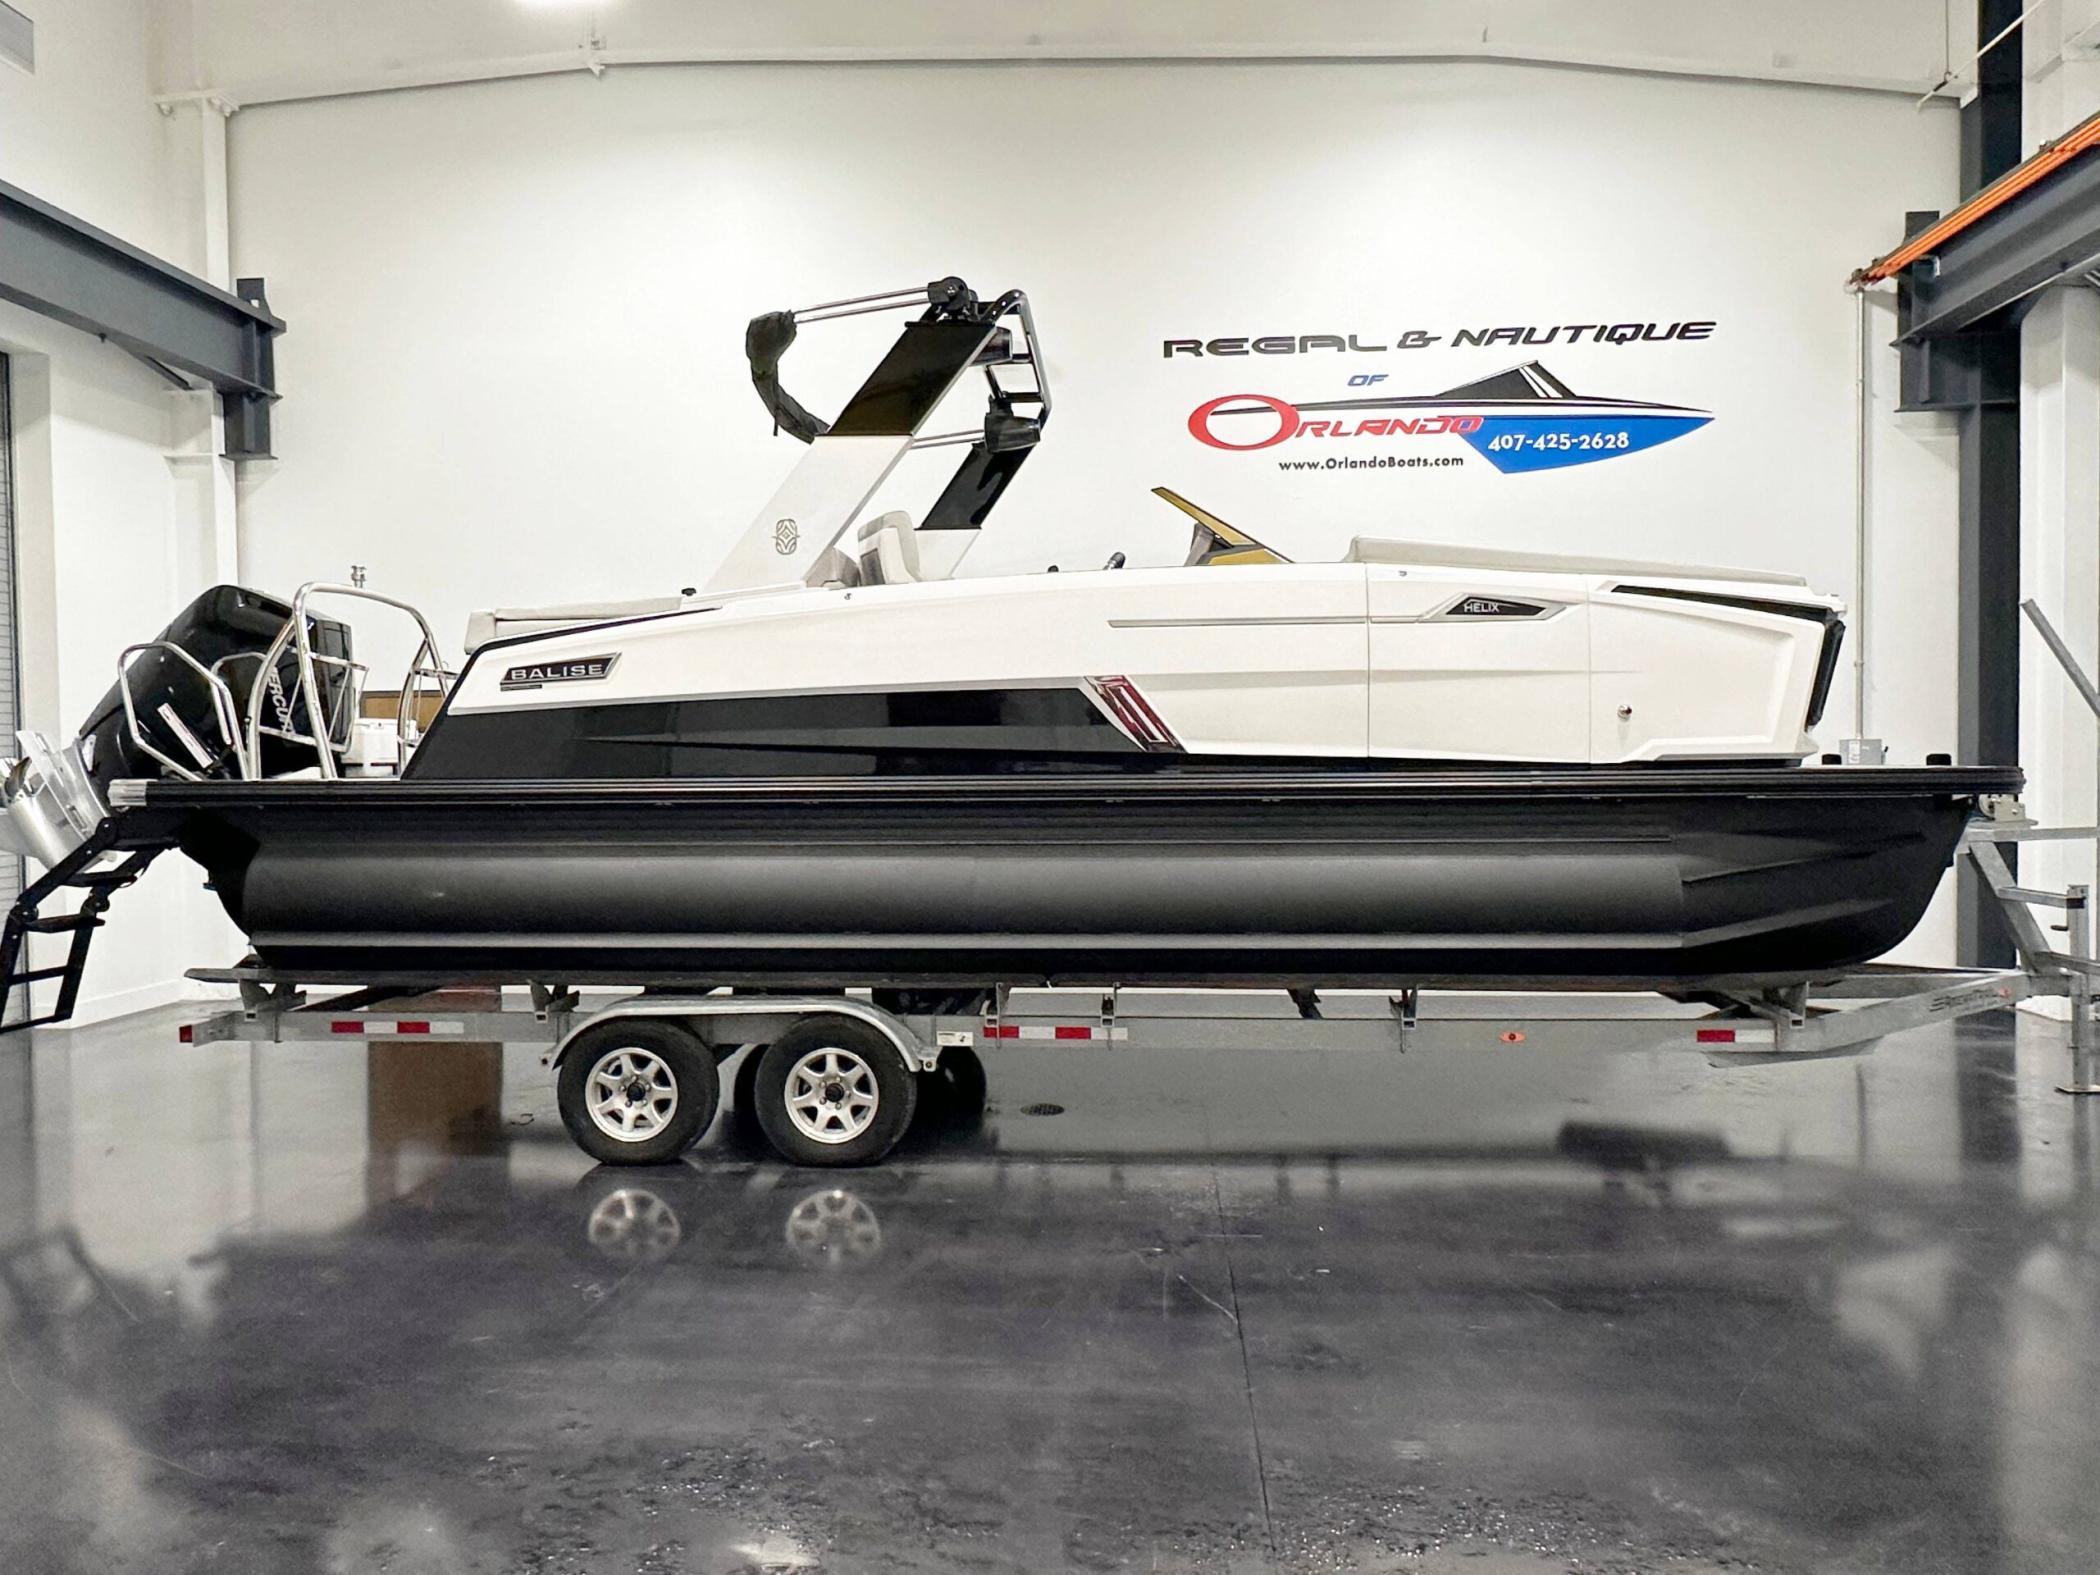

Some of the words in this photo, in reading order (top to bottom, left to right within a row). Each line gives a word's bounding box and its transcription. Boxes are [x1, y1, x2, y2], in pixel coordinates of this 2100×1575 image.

[1163, 334, 1388, 358] REGAL
[1396, 330, 1442, 349] &
[1450, 321, 1717, 347] NAUTIQUE
[1347, 373, 1390, 387] OF
[1187, 393, 1484, 451] ORLANDO
[1487, 431, 1630, 451] 407-425-2628
[1278, 455, 1464, 471] www.OrlandoBoats.com
[1463, 602, 1500, 613] HELIX
[511, 664, 603, 680] BALISE
